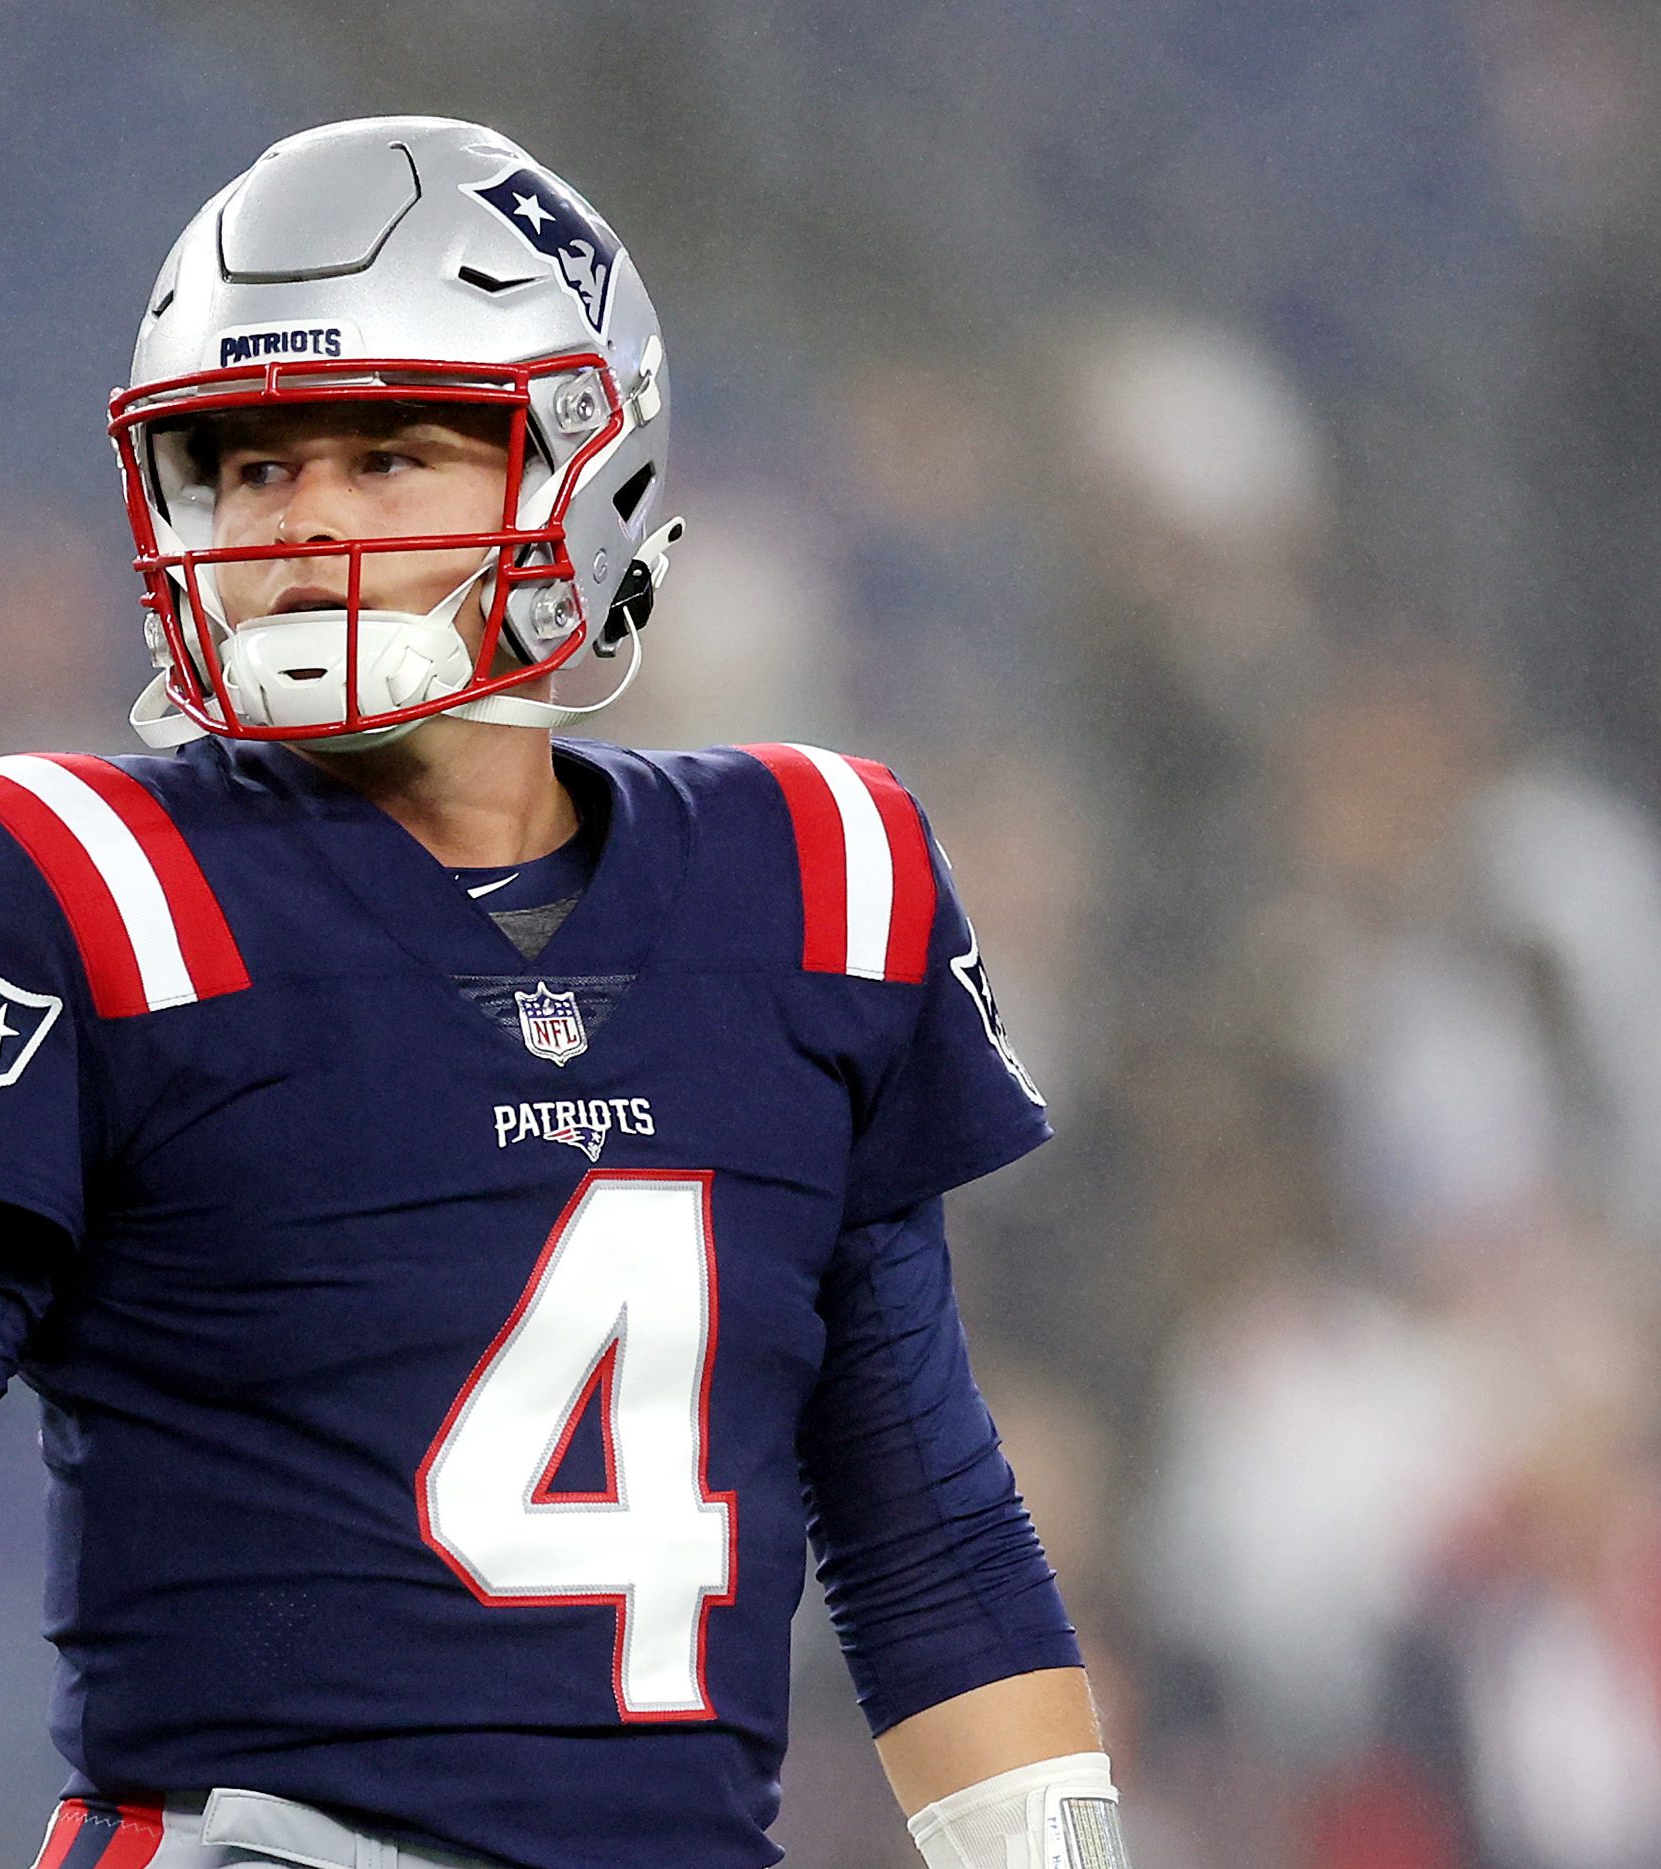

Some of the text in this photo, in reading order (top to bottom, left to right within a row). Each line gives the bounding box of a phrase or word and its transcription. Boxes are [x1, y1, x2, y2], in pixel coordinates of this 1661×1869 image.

[221, 328, 341, 367] PATRIOTS
[534, 1019, 578, 1048] NFL
[494, 1098, 655, 1148] PATRIOTS
[414, 1168, 737, 1723] 4
